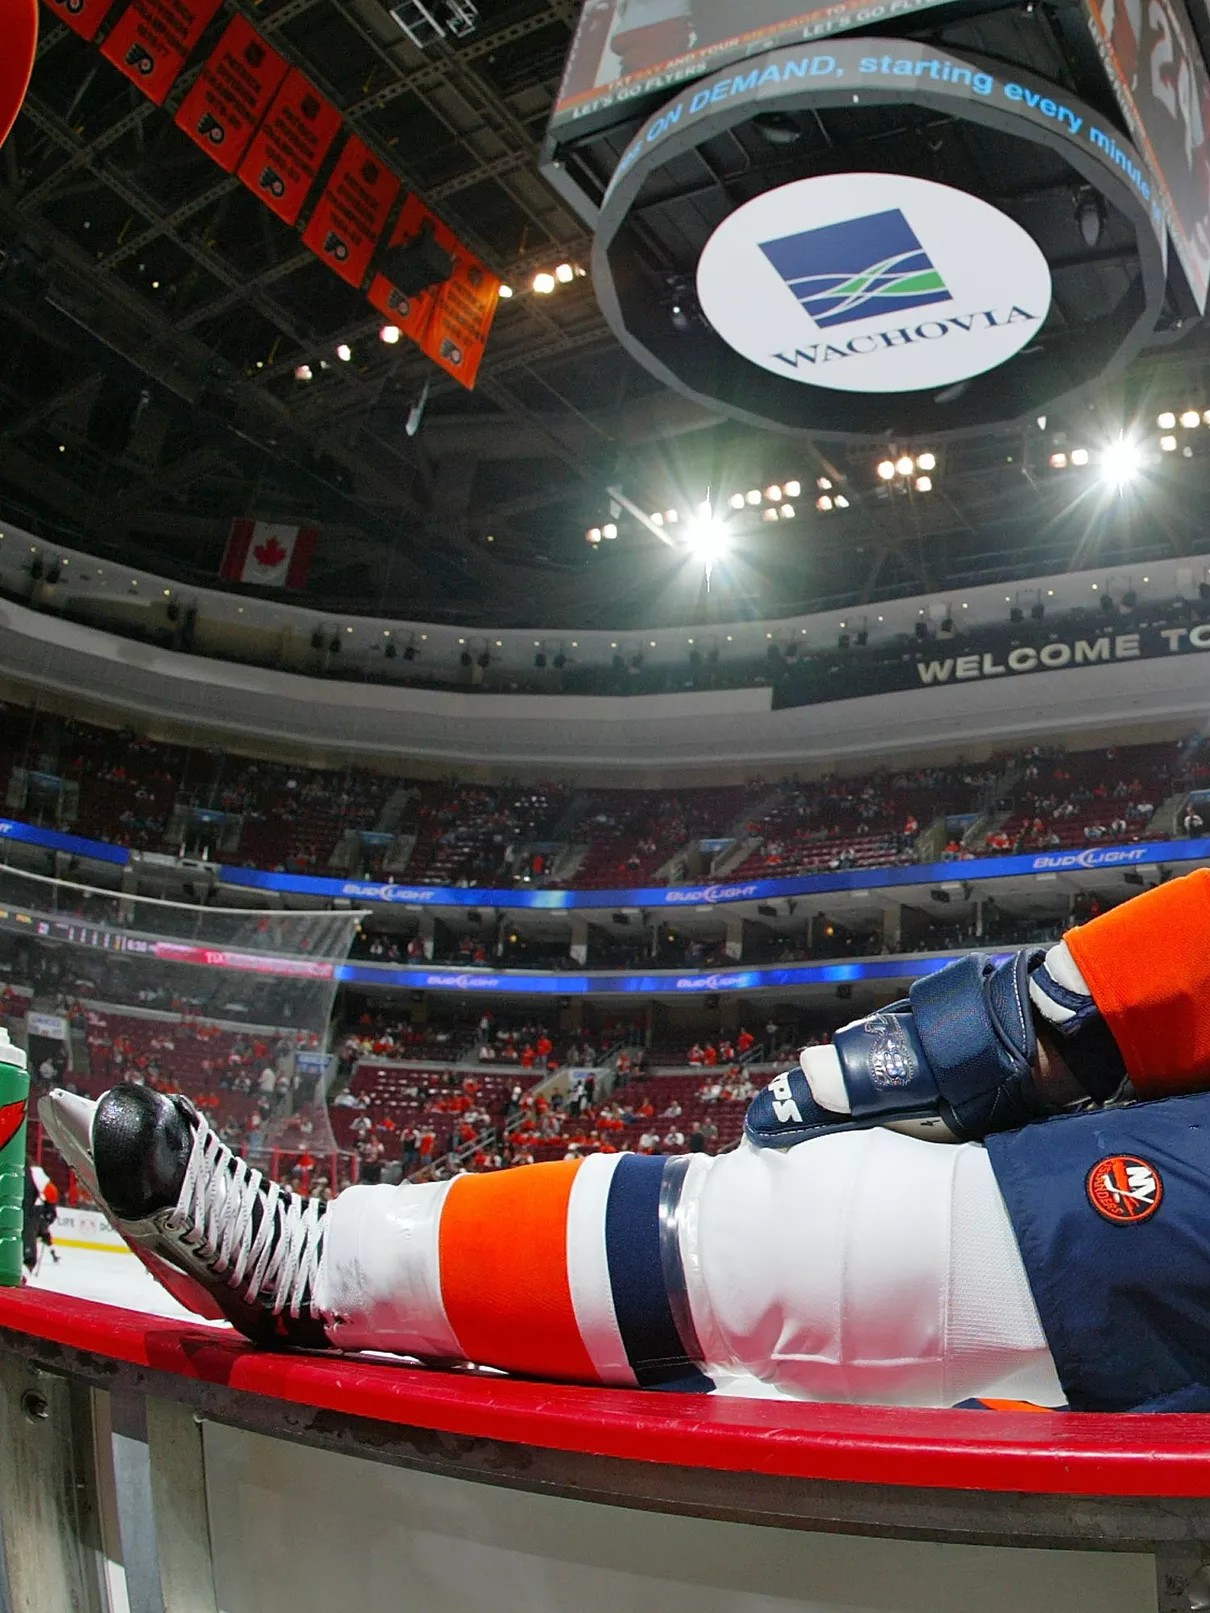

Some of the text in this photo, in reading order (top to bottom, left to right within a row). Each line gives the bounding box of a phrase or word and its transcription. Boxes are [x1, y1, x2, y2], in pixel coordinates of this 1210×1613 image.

[689, 55, 844, 113] DEMAND,
[858, 55, 994, 95] starting
[1004, 80, 1083, 134] every
[1089, 126, 1151, 200] minute
[772, 305, 1040, 369] WACHOVIA
[917, 633, 1141, 684] WELCOME
[1087, 848, 1147, 864] LIGHT
